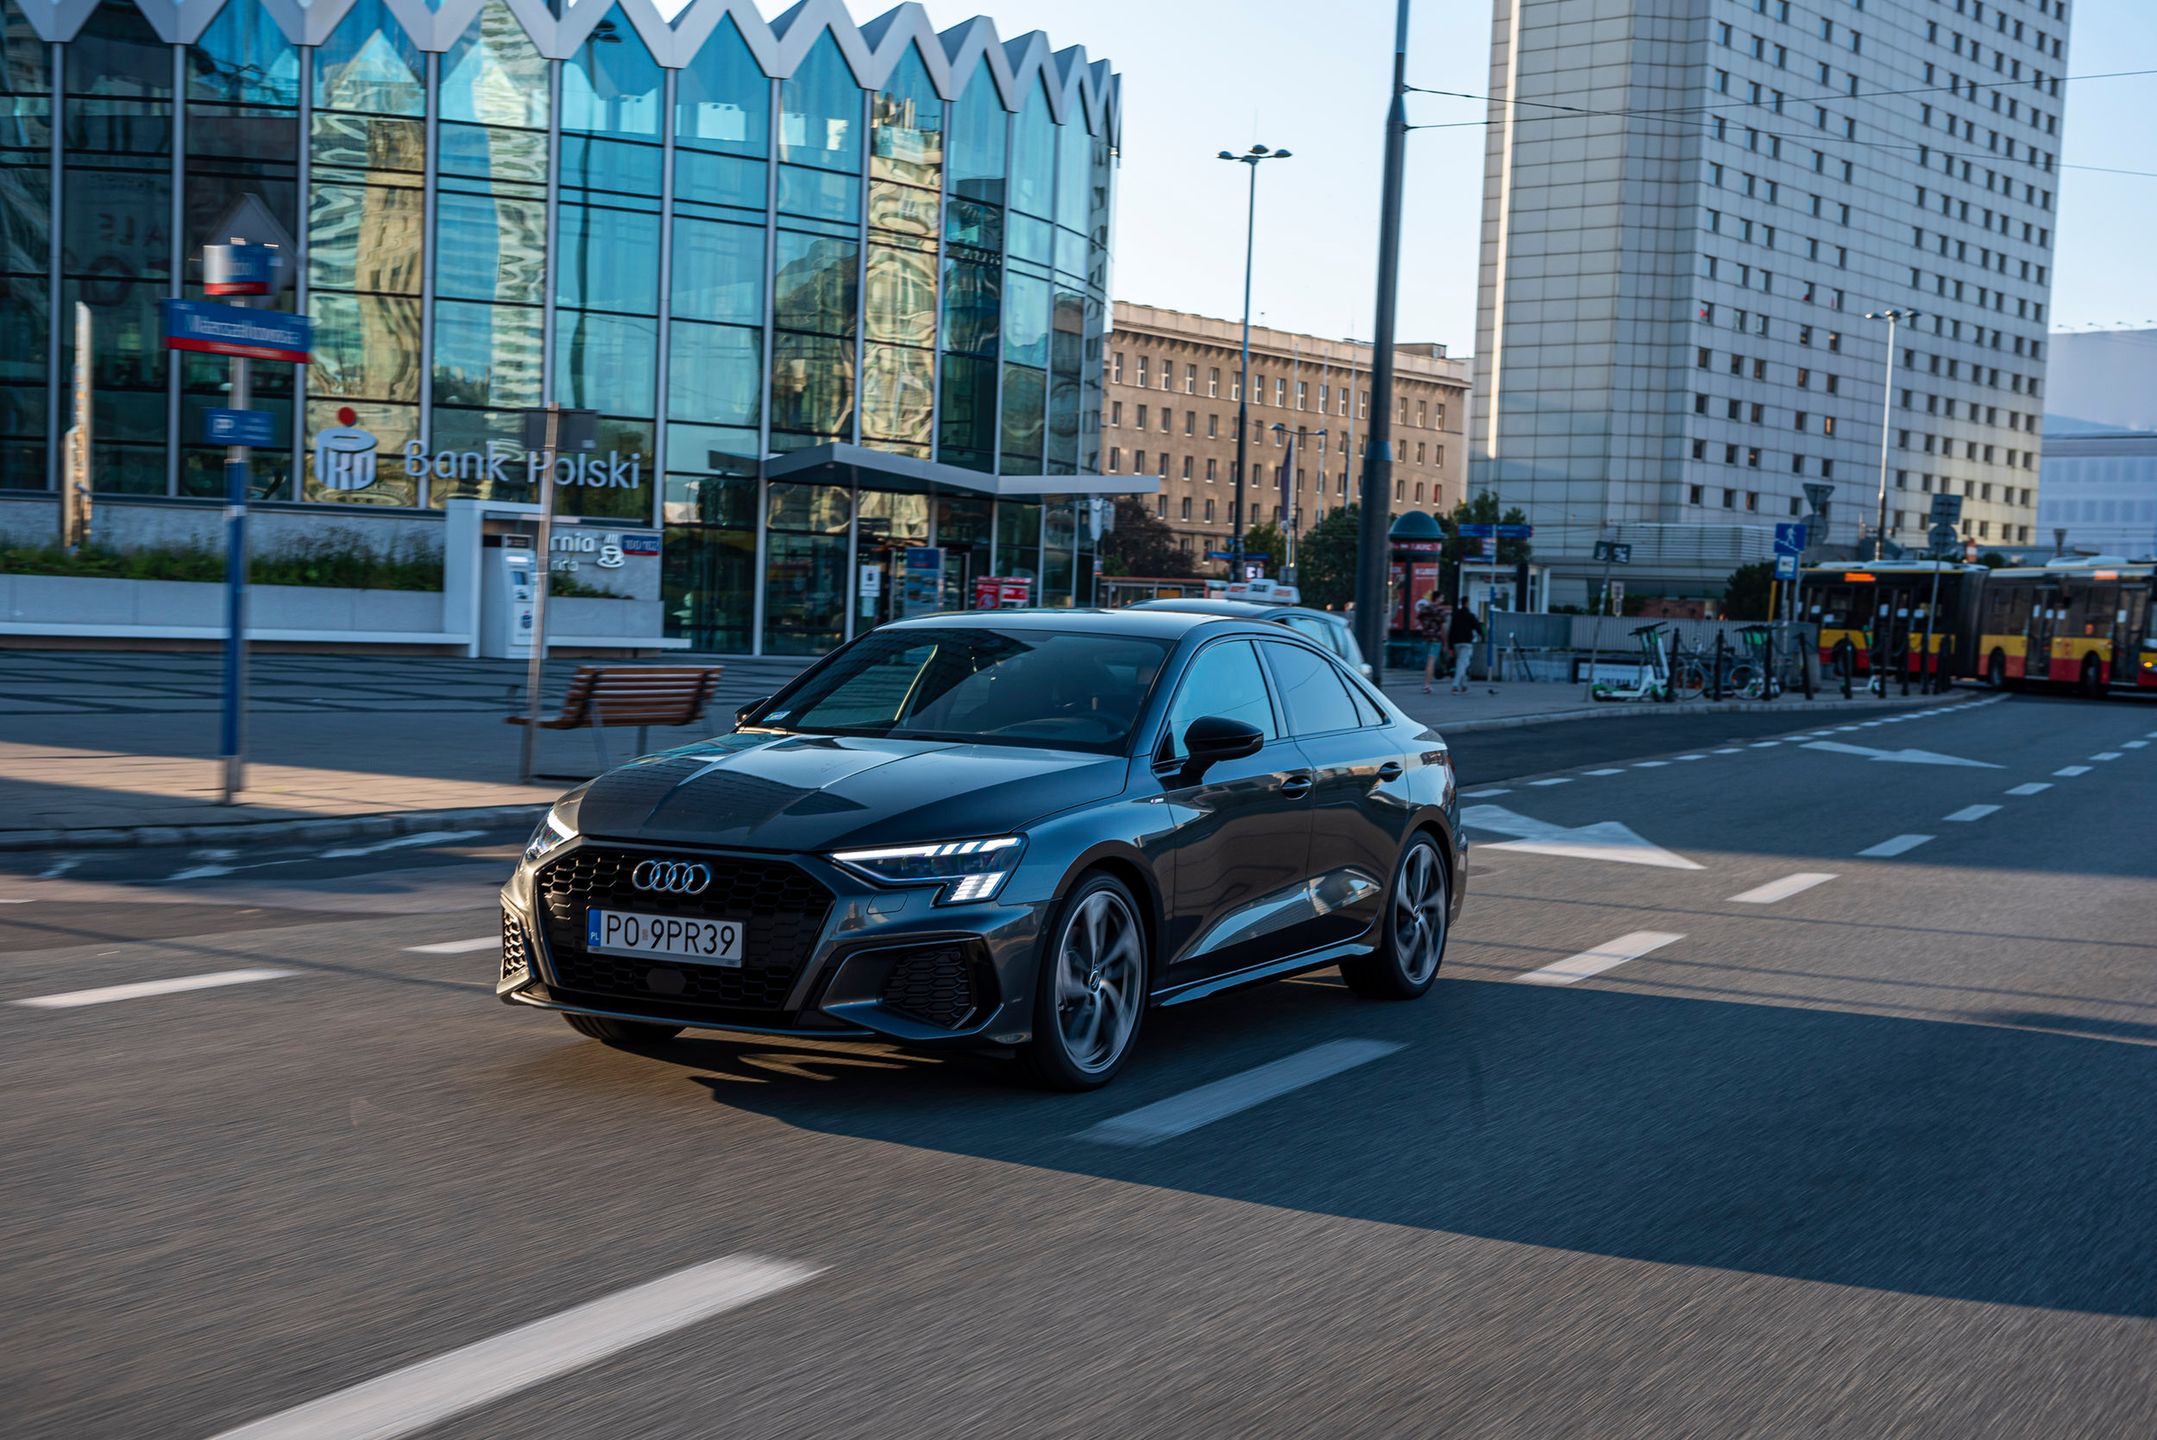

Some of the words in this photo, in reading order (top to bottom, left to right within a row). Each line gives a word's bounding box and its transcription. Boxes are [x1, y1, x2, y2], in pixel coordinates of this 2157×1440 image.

[404, 439, 509, 482] Bank
[528, 450, 640, 489] Polski
[590, 931, 600, 941] PL
[606, 914, 639, 947] PO
[651, 919, 735, 956] 9PR39
